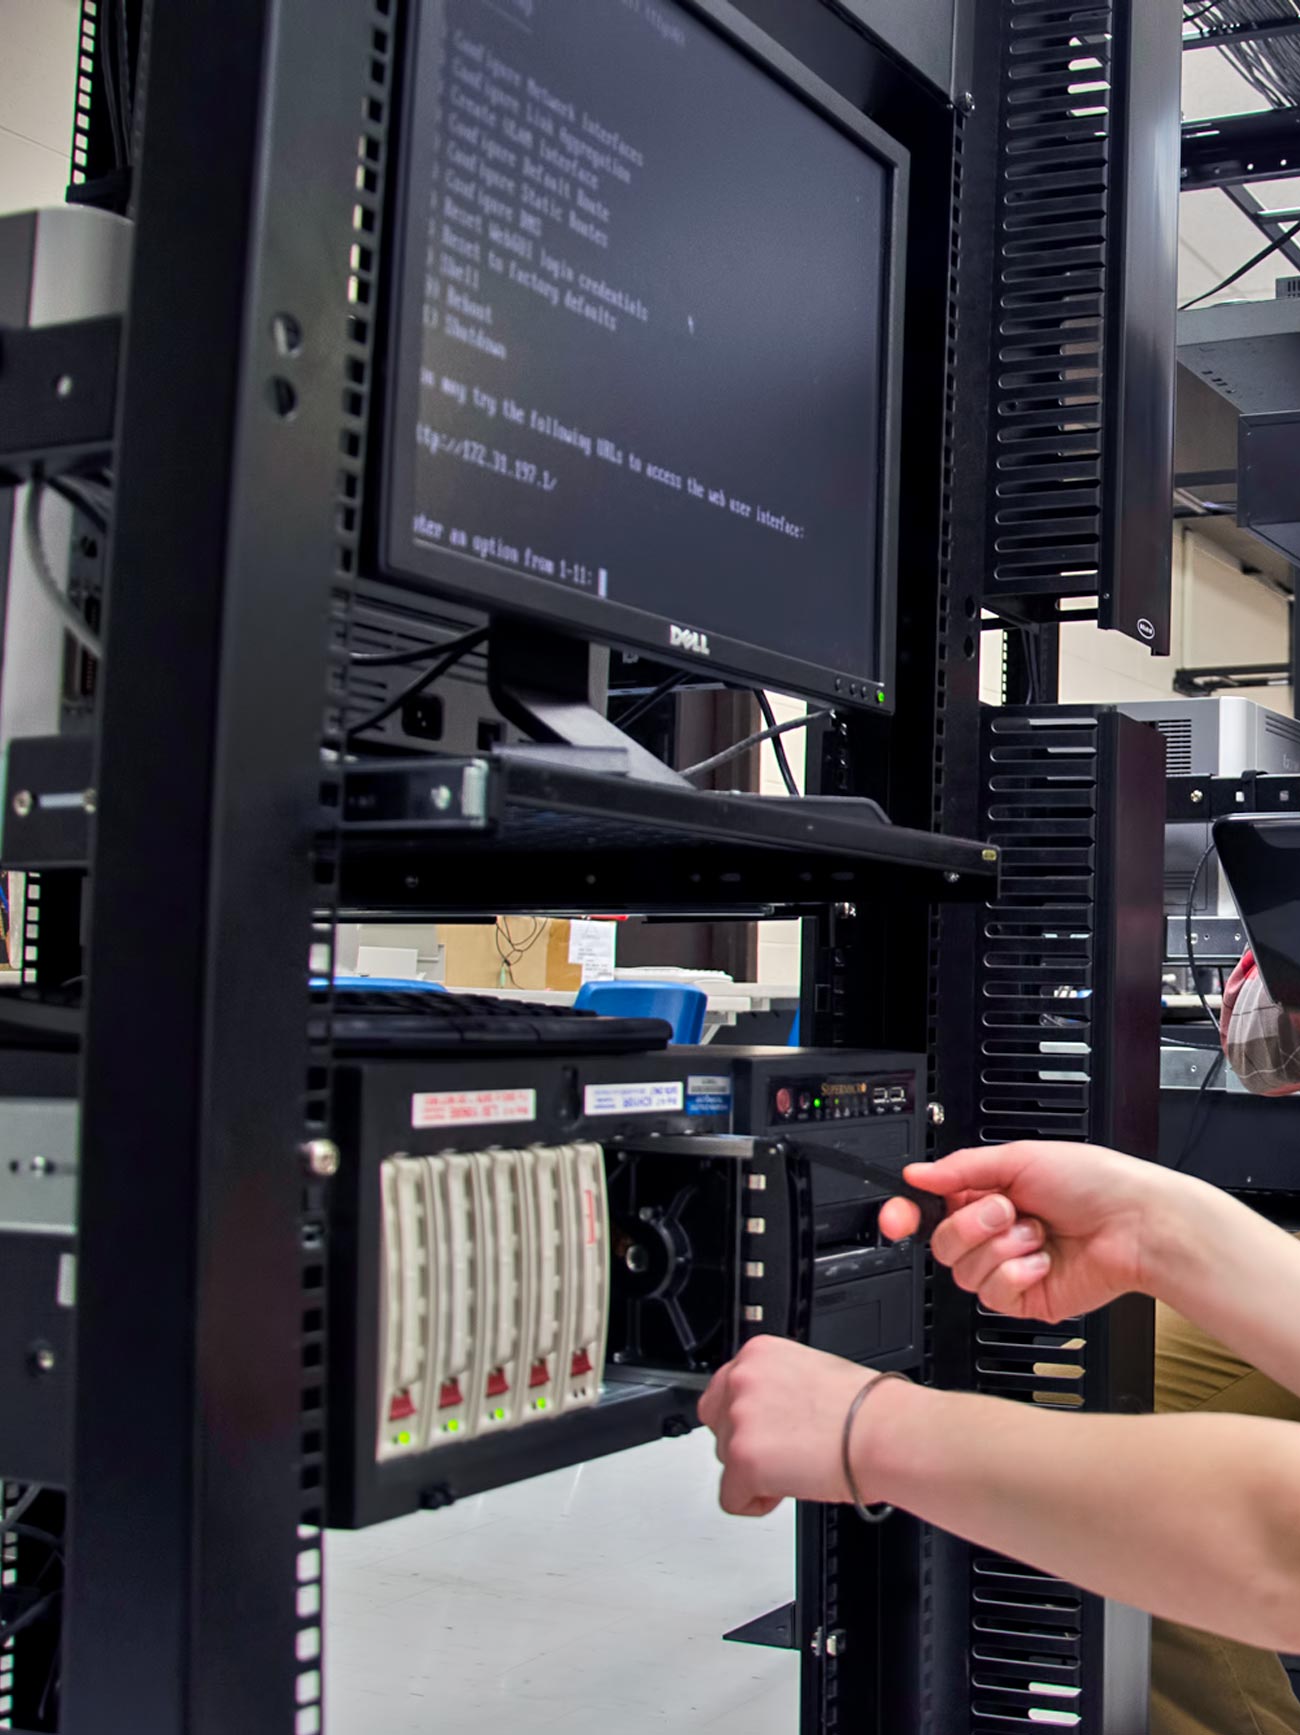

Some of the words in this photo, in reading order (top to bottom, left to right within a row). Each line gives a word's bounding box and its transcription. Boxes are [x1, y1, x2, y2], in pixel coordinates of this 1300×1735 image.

[565, 290, 616, 331] defaults
[579, 273, 648, 321] credentials
[441, 376, 467, 405] may
[473, 387, 497, 417] try
[502, 398, 525, 425] the
[529, 408, 592, 457] following
[596, 438, 623, 465] URLs
[628, 451, 642, 473] to
[645, 463, 682, 491] access
[687, 477, 705, 499] the
[707, 488, 726, 508] web
[729, 498, 751, 518] user
[756, 504, 804, 539] interface:
[449, 527, 468, 548] an
[472, 534, 520, 565] option
[524, 547, 555, 574] from
[560, 557, 593, 586] 1-11:
[670, 623, 710, 656] DELL
